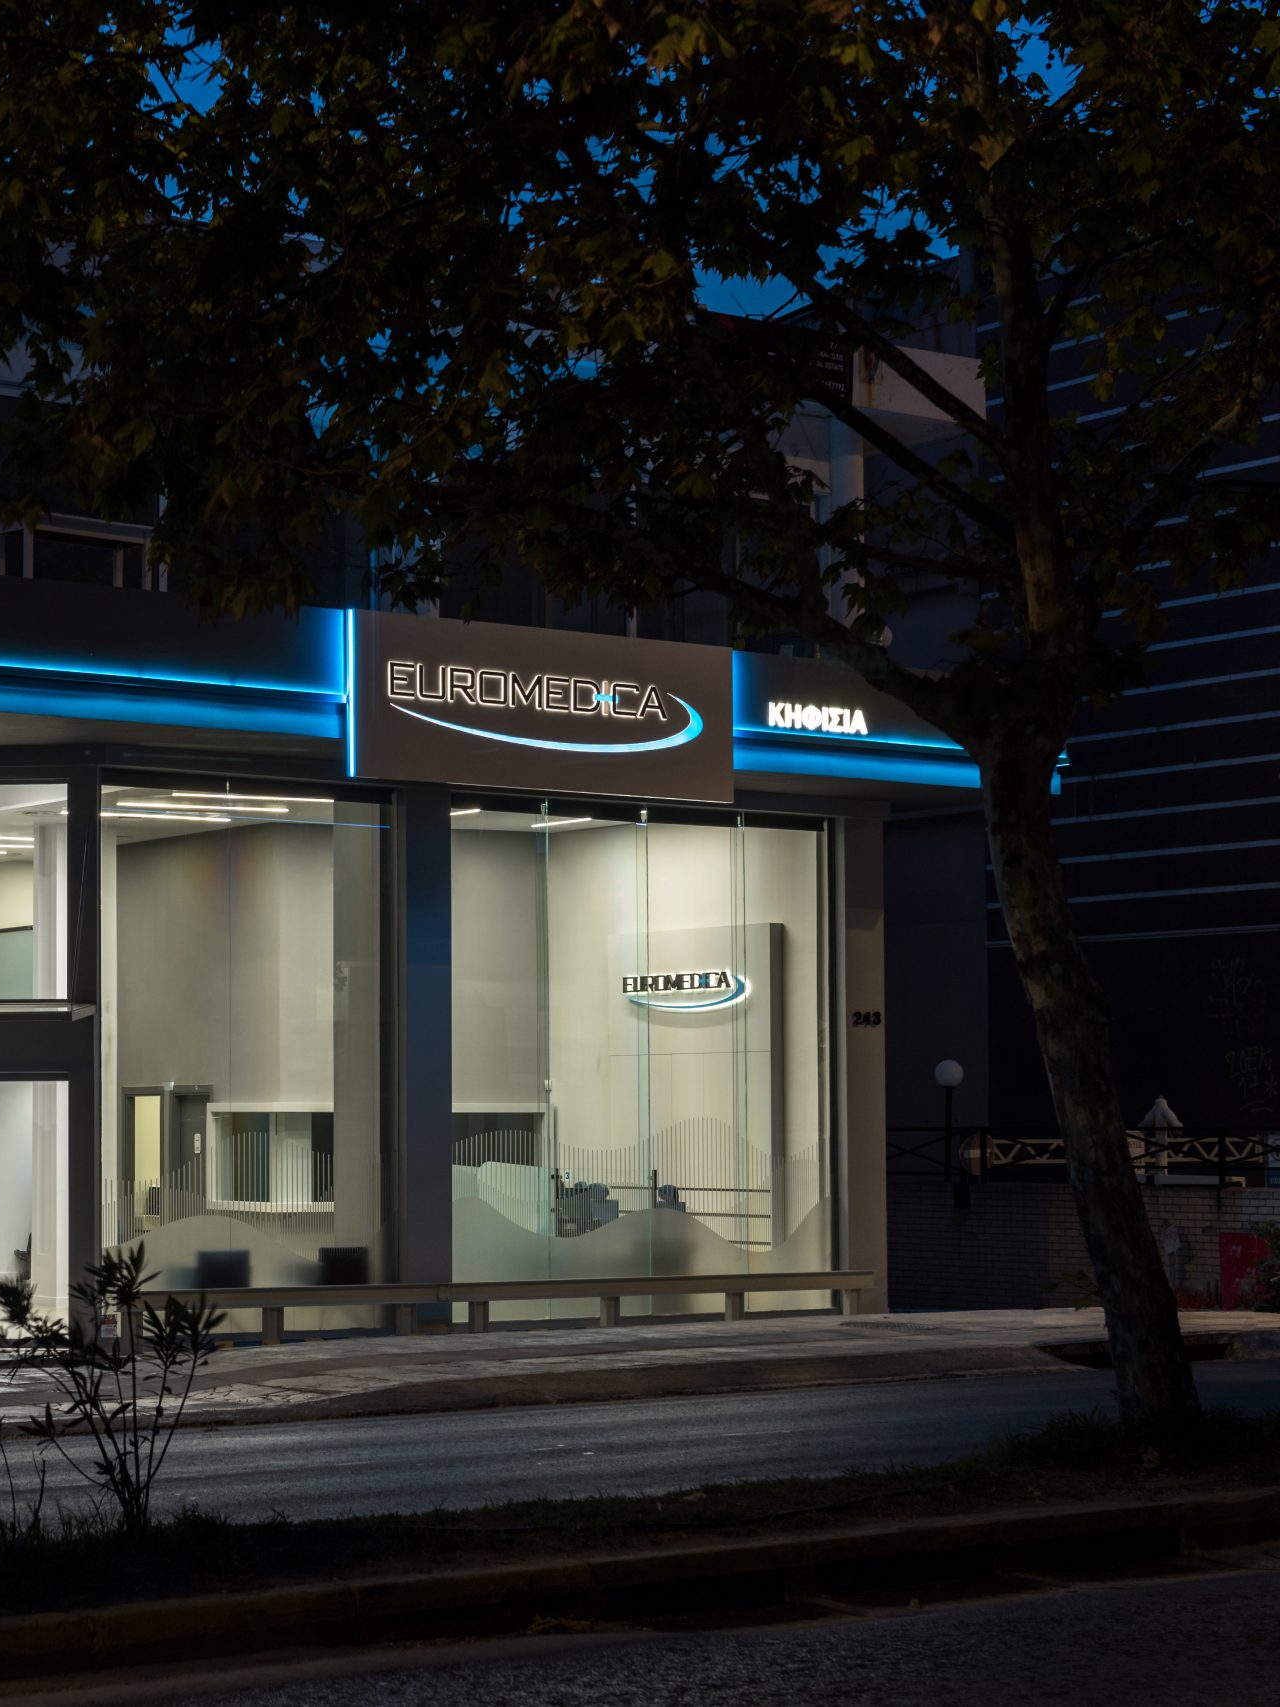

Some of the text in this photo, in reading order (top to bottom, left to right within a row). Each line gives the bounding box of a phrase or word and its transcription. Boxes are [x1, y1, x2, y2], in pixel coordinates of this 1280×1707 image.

[387, 660, 668, 721] EUROMEDICA
[768, 701, 869, 735] ΚΗΦΙΣΙΑ
[622, 971, 732, 993] EUROMEDICA
[853, 1011, 882, 1025] 243
